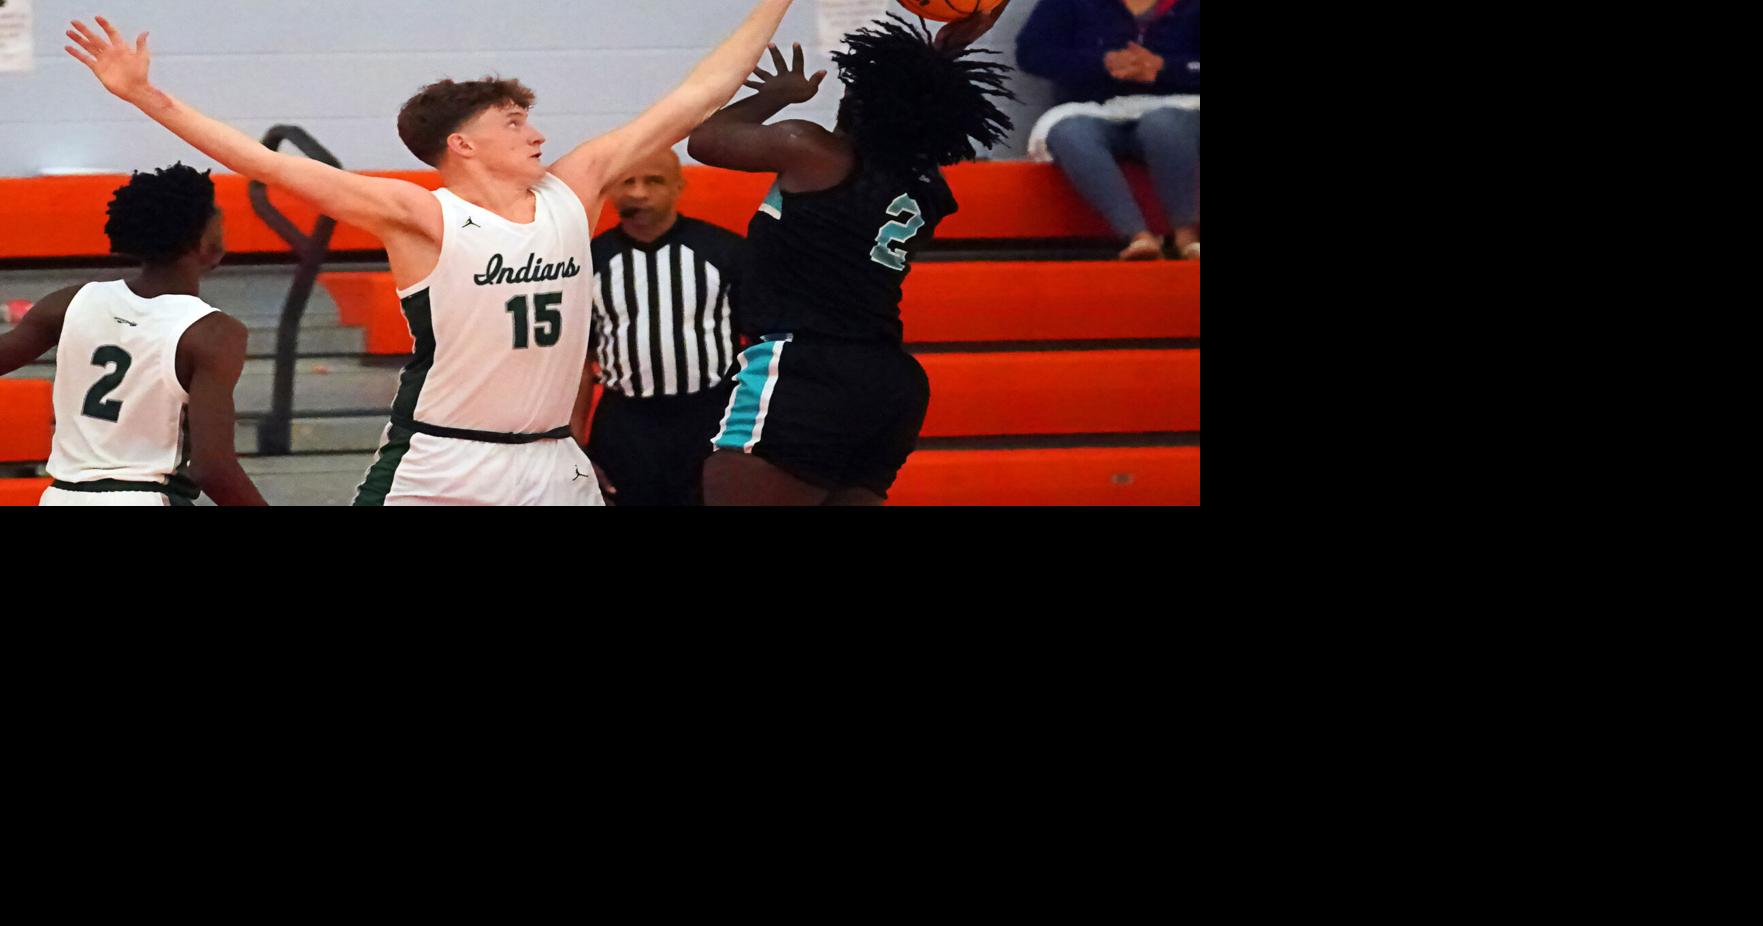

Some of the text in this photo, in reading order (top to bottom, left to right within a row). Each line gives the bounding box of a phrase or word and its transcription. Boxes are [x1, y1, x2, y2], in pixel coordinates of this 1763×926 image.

[870, 192, 925, 271] 2
[473, 252, 581, 286] Indians
[505, 290, 563, 350] 15
[81, 344, 132, 424] 2
